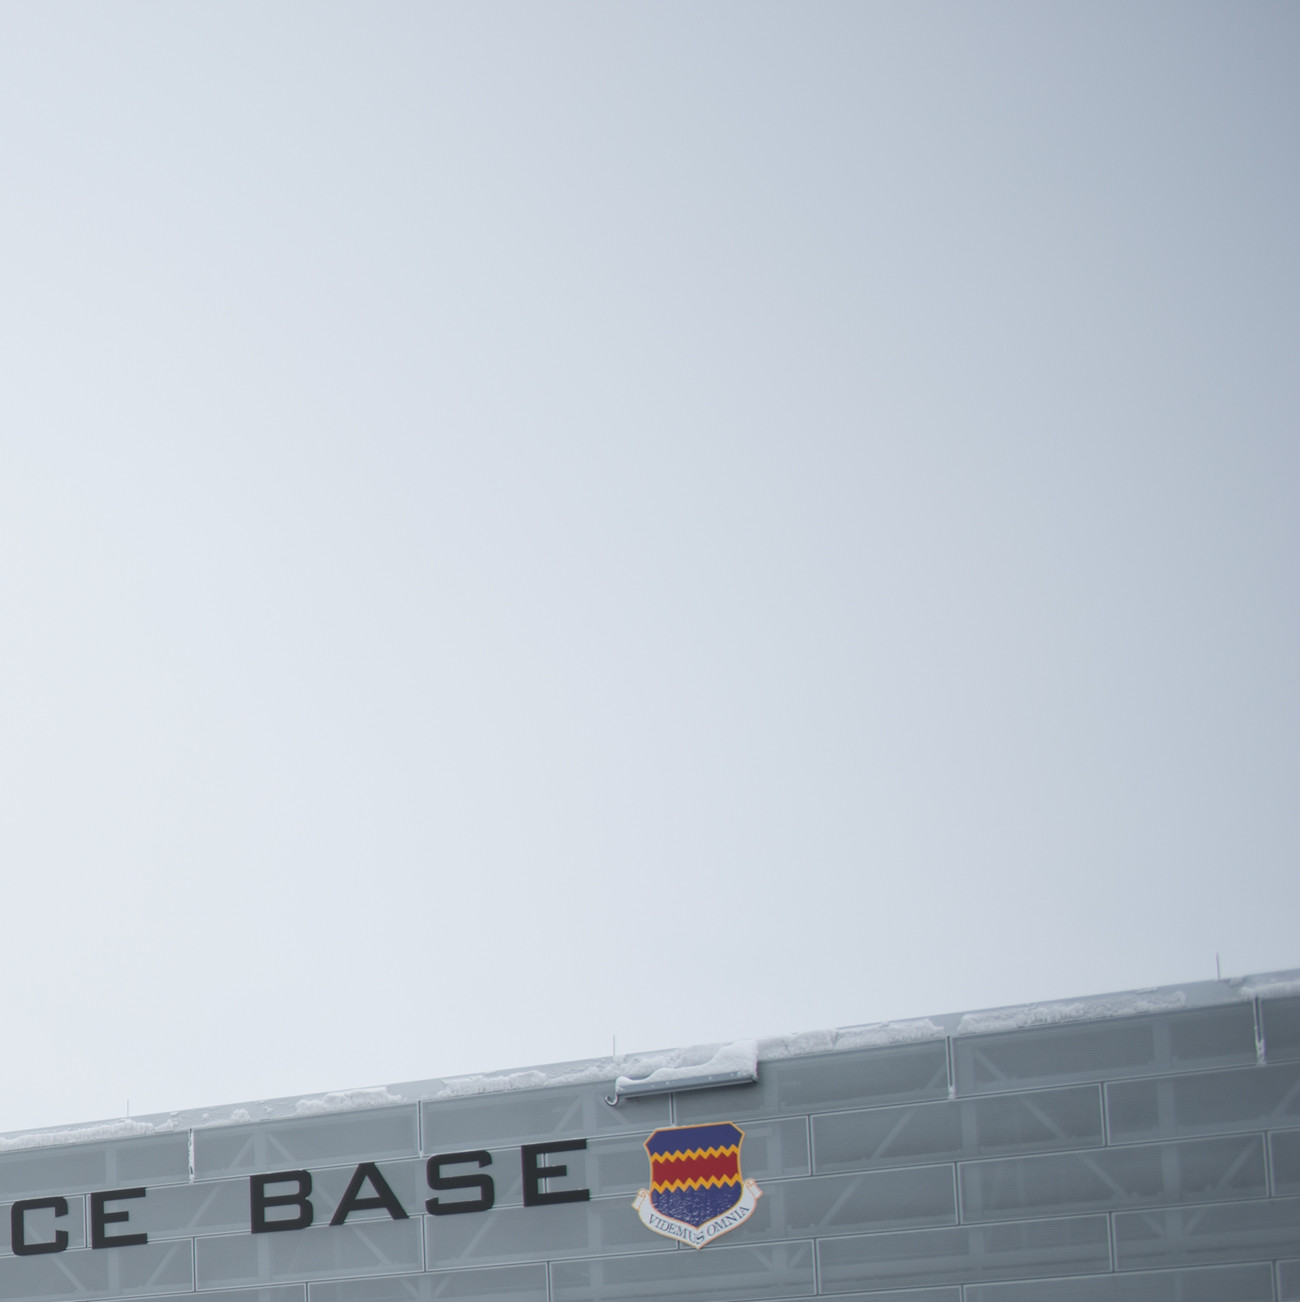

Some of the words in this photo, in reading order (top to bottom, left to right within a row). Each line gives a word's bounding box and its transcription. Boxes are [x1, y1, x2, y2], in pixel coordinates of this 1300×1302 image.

[251, 1138, 590, 1234] BASE
[648, 1213, 705, 1244] VIDEMUS
[706, 1205, 749, 1237] OMNIA
